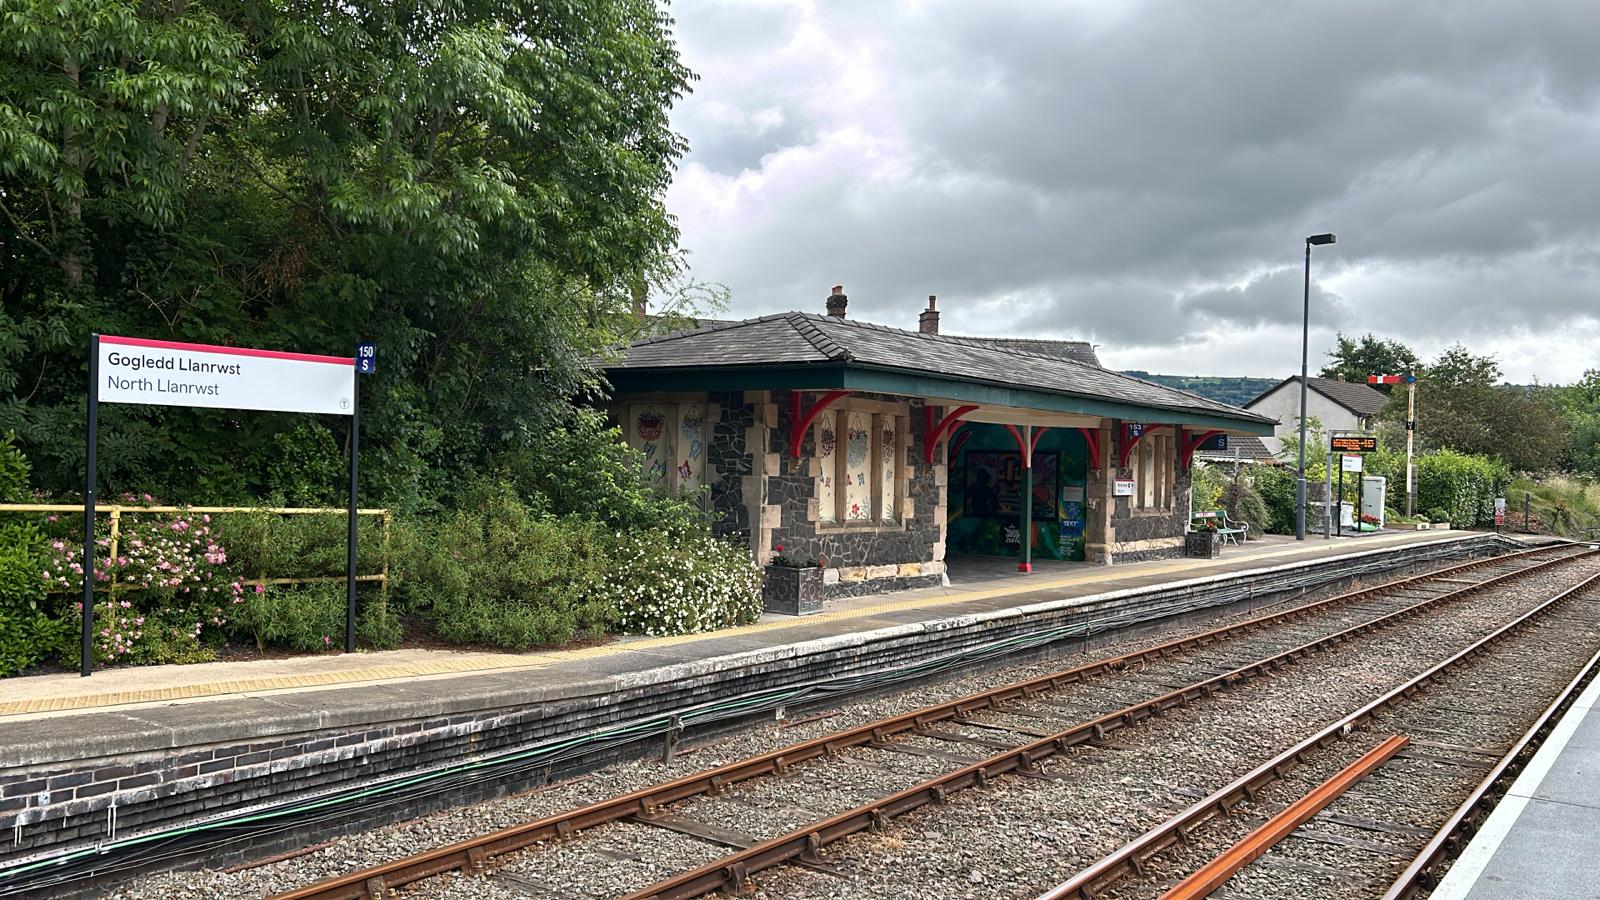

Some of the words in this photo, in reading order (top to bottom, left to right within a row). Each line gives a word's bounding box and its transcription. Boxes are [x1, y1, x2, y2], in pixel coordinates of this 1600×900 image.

[359, 346, 374, 358] 150
[108, 352, 175, 371] Gogledd
[179, 357, 241, 376] Llanrwst
[362, 359, 369, 371] S
[108, 375, 153, 392] North
[157, 378, 219, 396] Llanrwst
